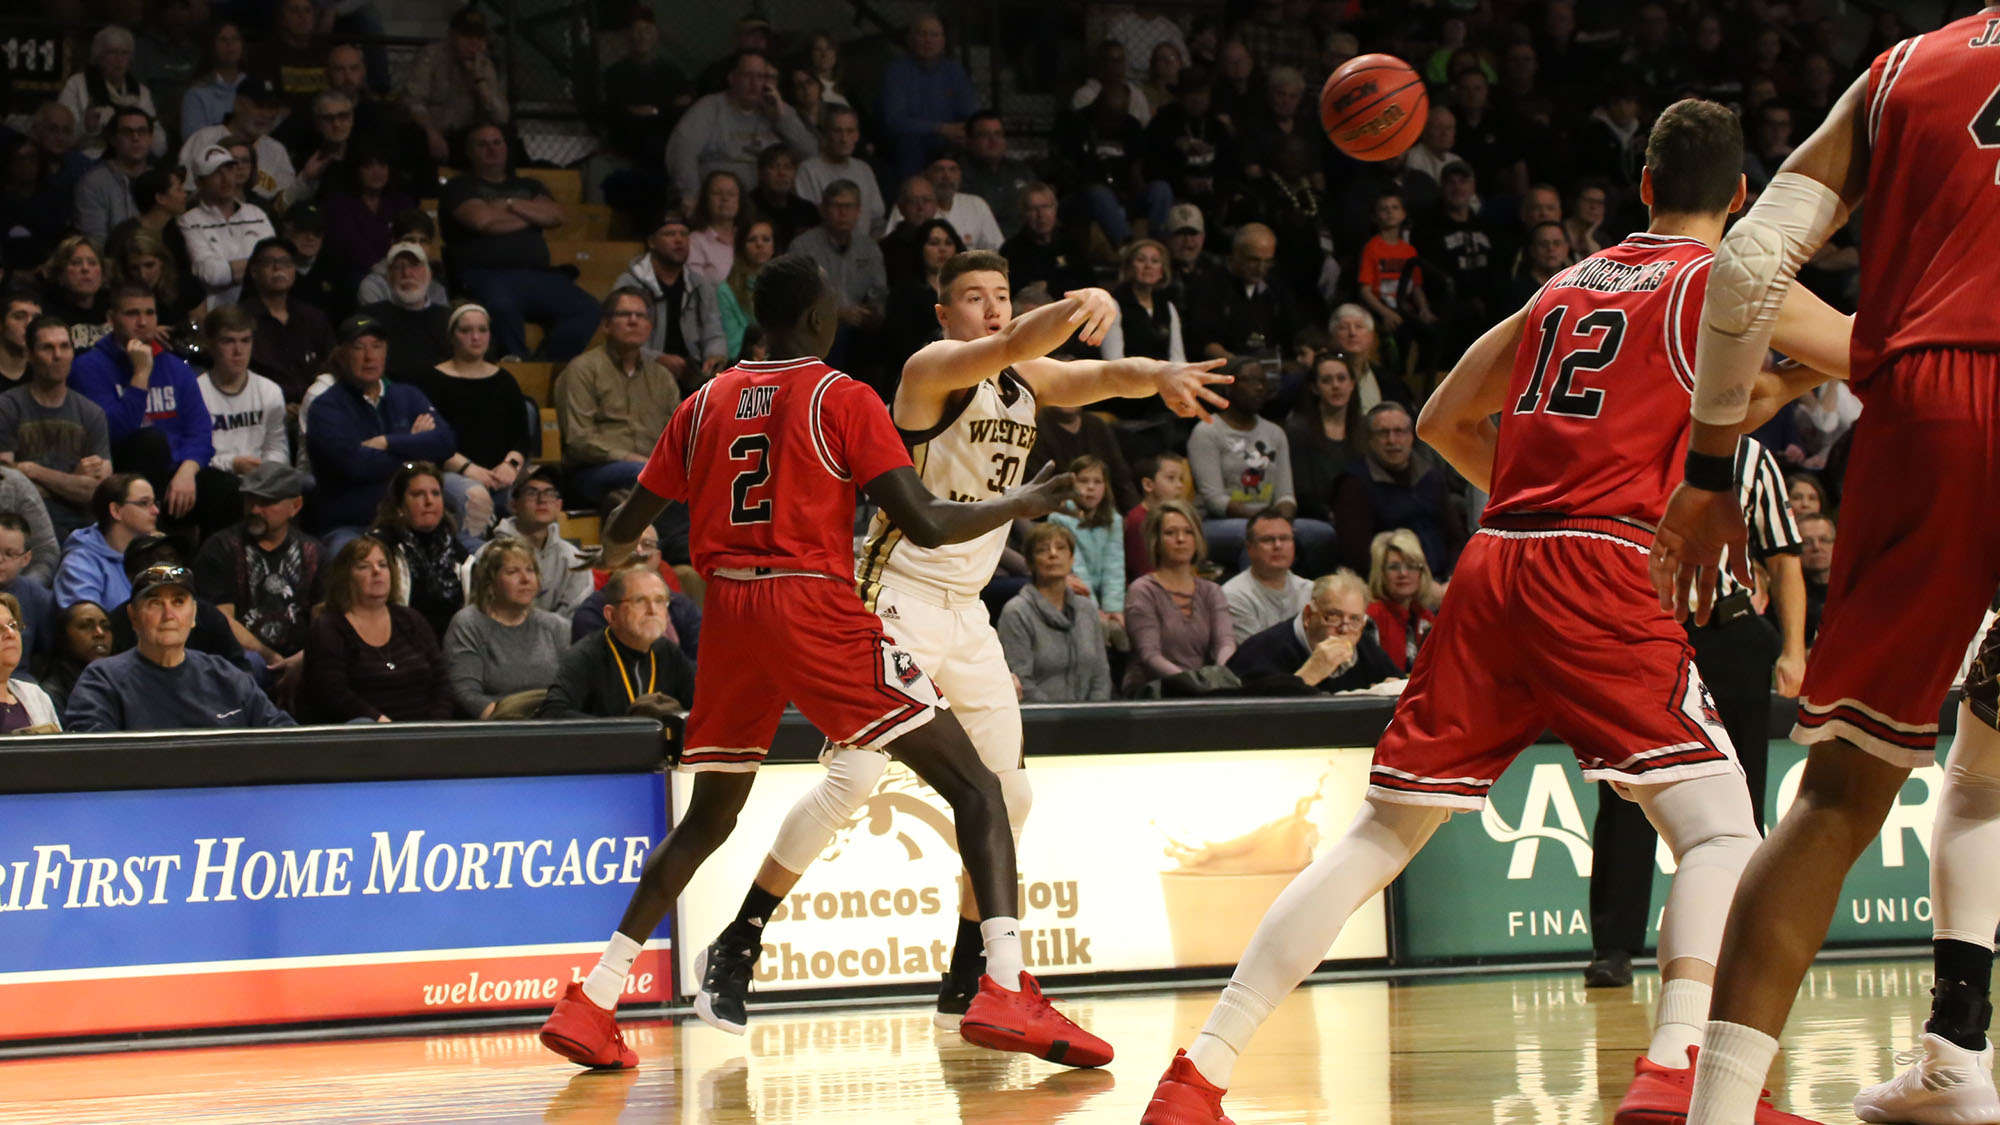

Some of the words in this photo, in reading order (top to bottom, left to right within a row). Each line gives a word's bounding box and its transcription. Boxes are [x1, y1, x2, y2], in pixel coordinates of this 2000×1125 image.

[1, 37, 55, 71] 111
[1513, 305, 1628, 419] 12
[211, 411, 264, 431] AMILY
[728, 433, 772, 526] 2
[987, 452, 1020, 493] 30
[0, 844, 181, 912] IFIRST
[186, 837, 353, 903] HOME
[362, 830, 650, 895] MORTGAGE
[1852, 896, 1932, 924] UNIO
[752, 936, 955, 982] Chocolat
[423, 971, 559, 1006] welcome
